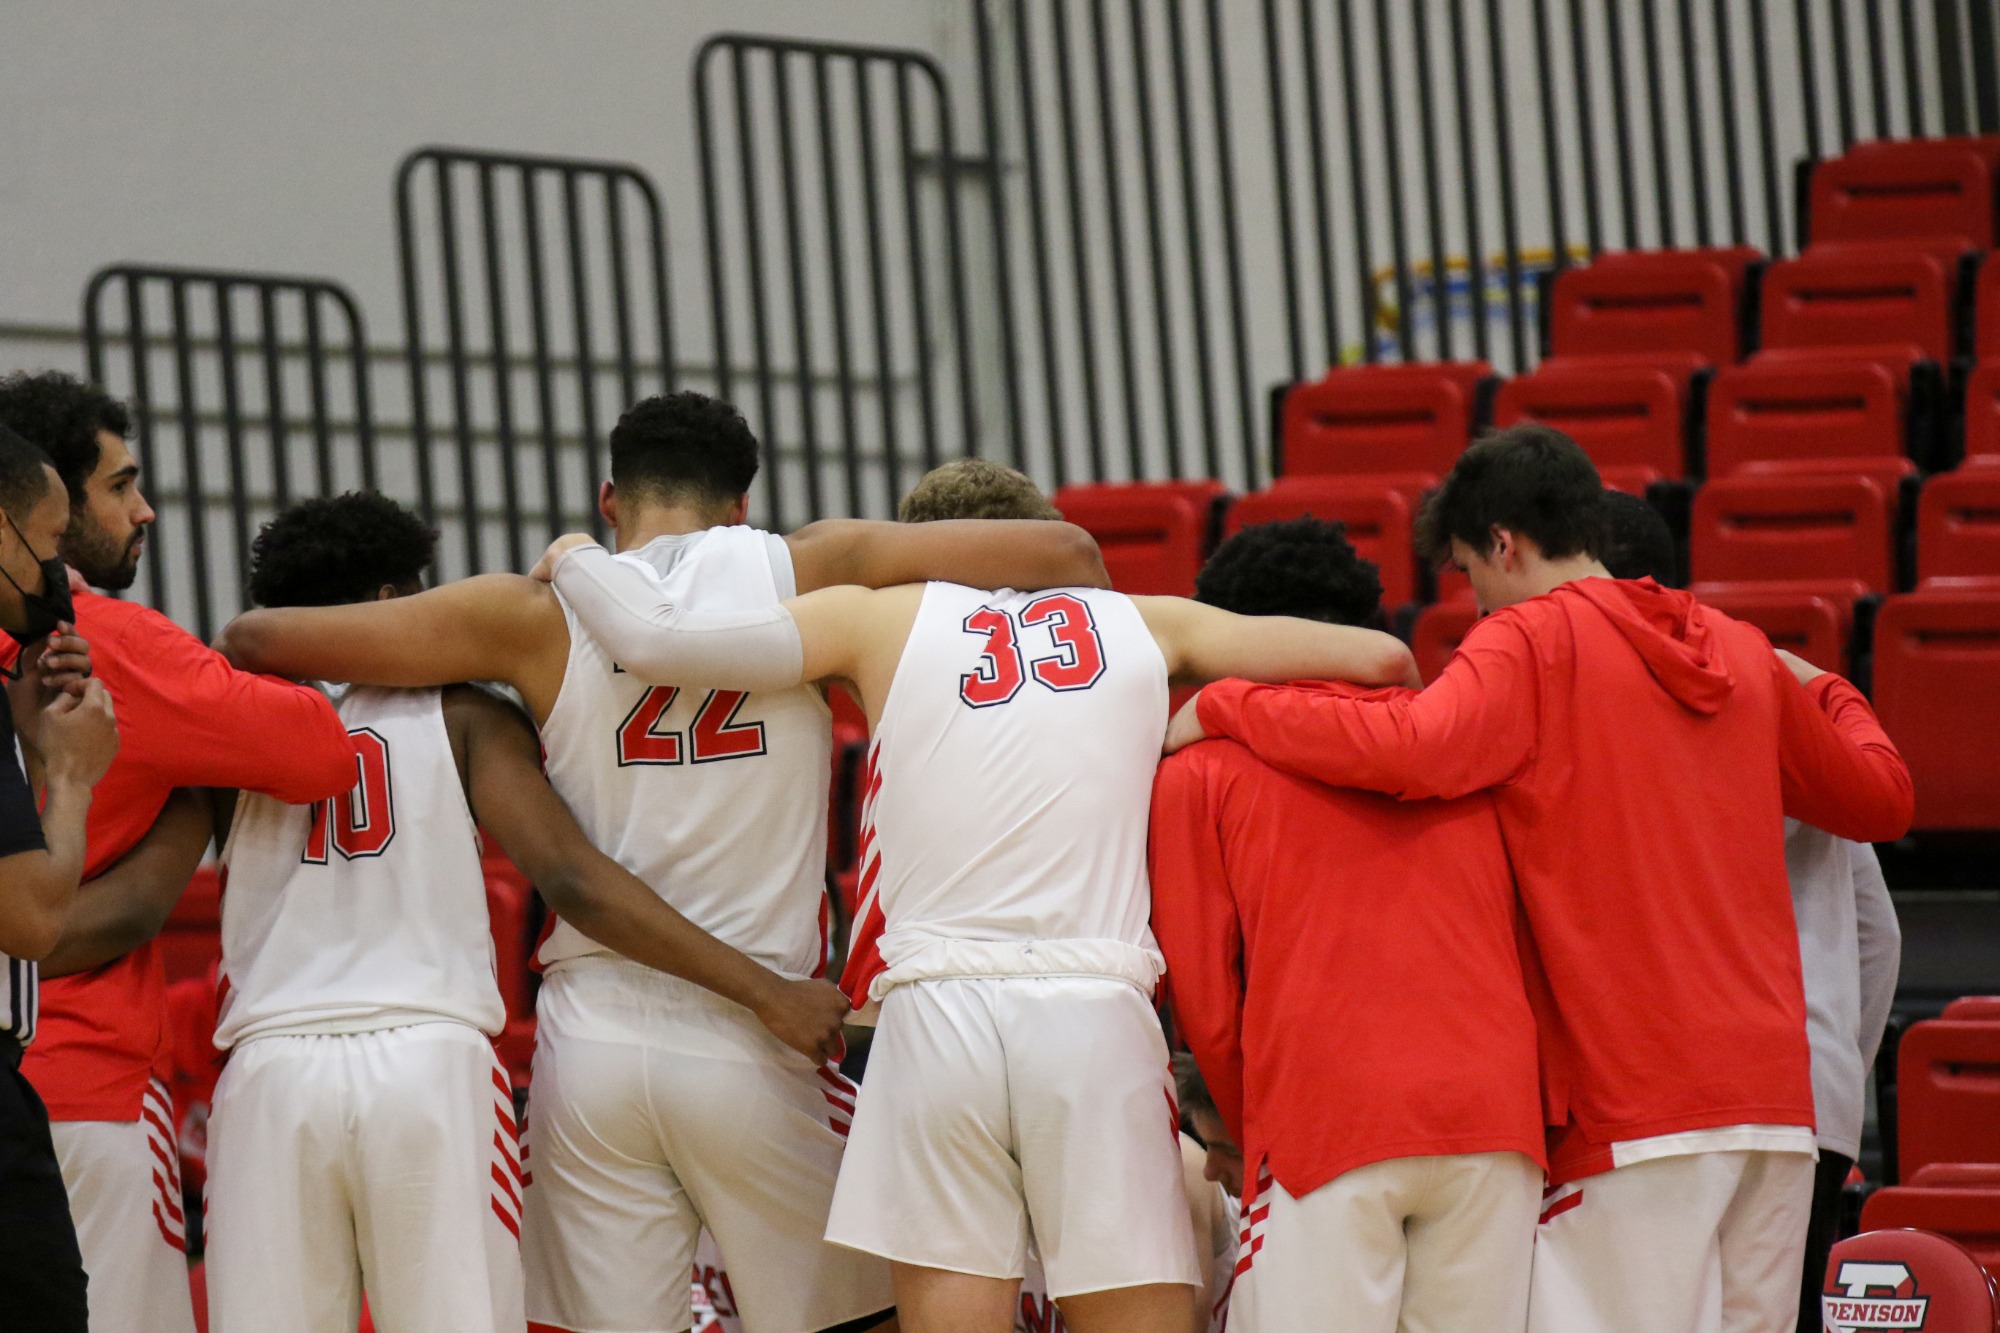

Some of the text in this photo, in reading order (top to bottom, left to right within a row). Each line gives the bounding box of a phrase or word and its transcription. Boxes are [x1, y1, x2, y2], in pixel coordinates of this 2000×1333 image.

[960, 592, 1108, 710] 33
[615, 685, 768, 768] 22
[1826, 1302, 1922, 1322] DENISON
